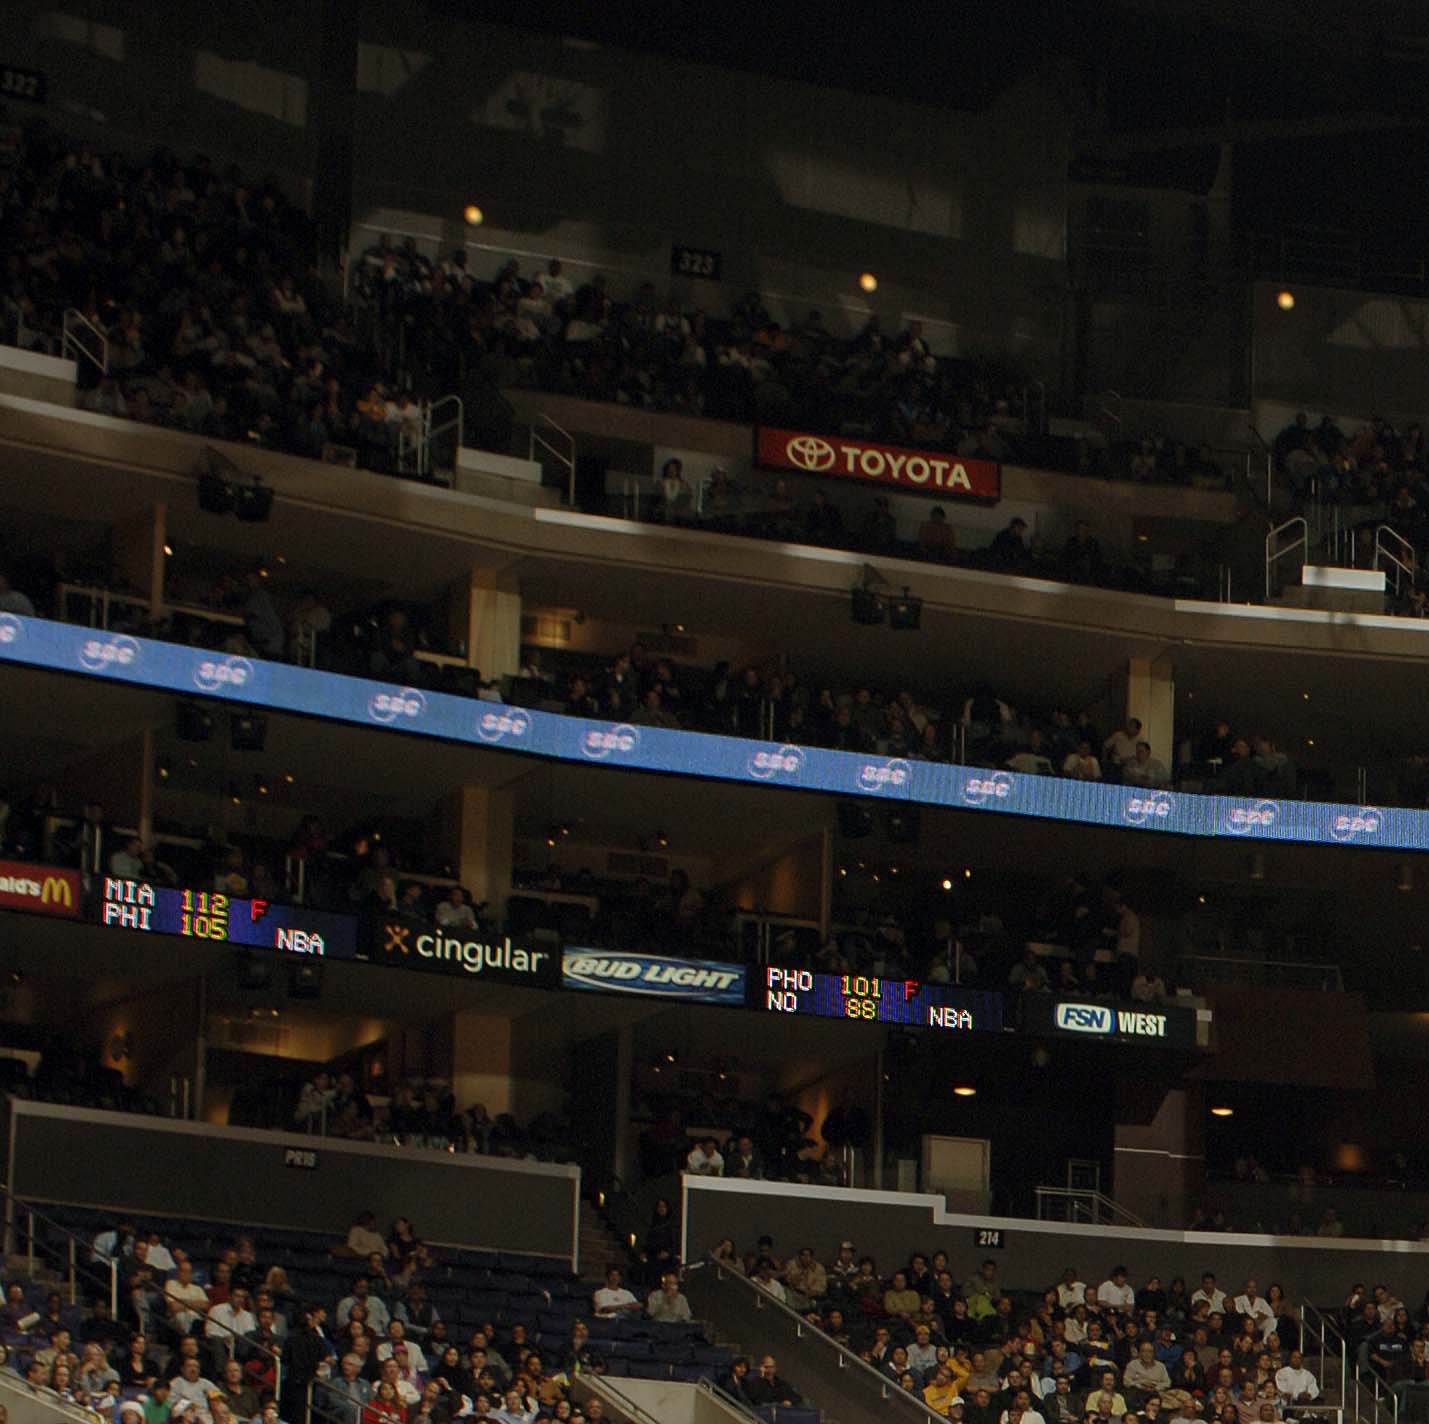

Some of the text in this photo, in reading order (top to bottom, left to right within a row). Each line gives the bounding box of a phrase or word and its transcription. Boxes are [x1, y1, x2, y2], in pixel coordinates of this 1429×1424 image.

[841, 446, 972, 490] TOYOTA
[104, 877, 268, 919] MIA 112 F
[103, 902, 227, 940] PHI 105
[276, 928, 324, 954] NBA
[416, 930, 541, 972] cingular
[571, 957, 740, 989] BUD LIGHT
[767, 968, 918, 1001] PHO 101 F
[767, 990, 877, 1020] NO 88
[929, 1005, 972, 1030] NBA
[1063, 1007, 1167, 1037] FSN WEST
[979, 1230, 1000, 1246] 214
